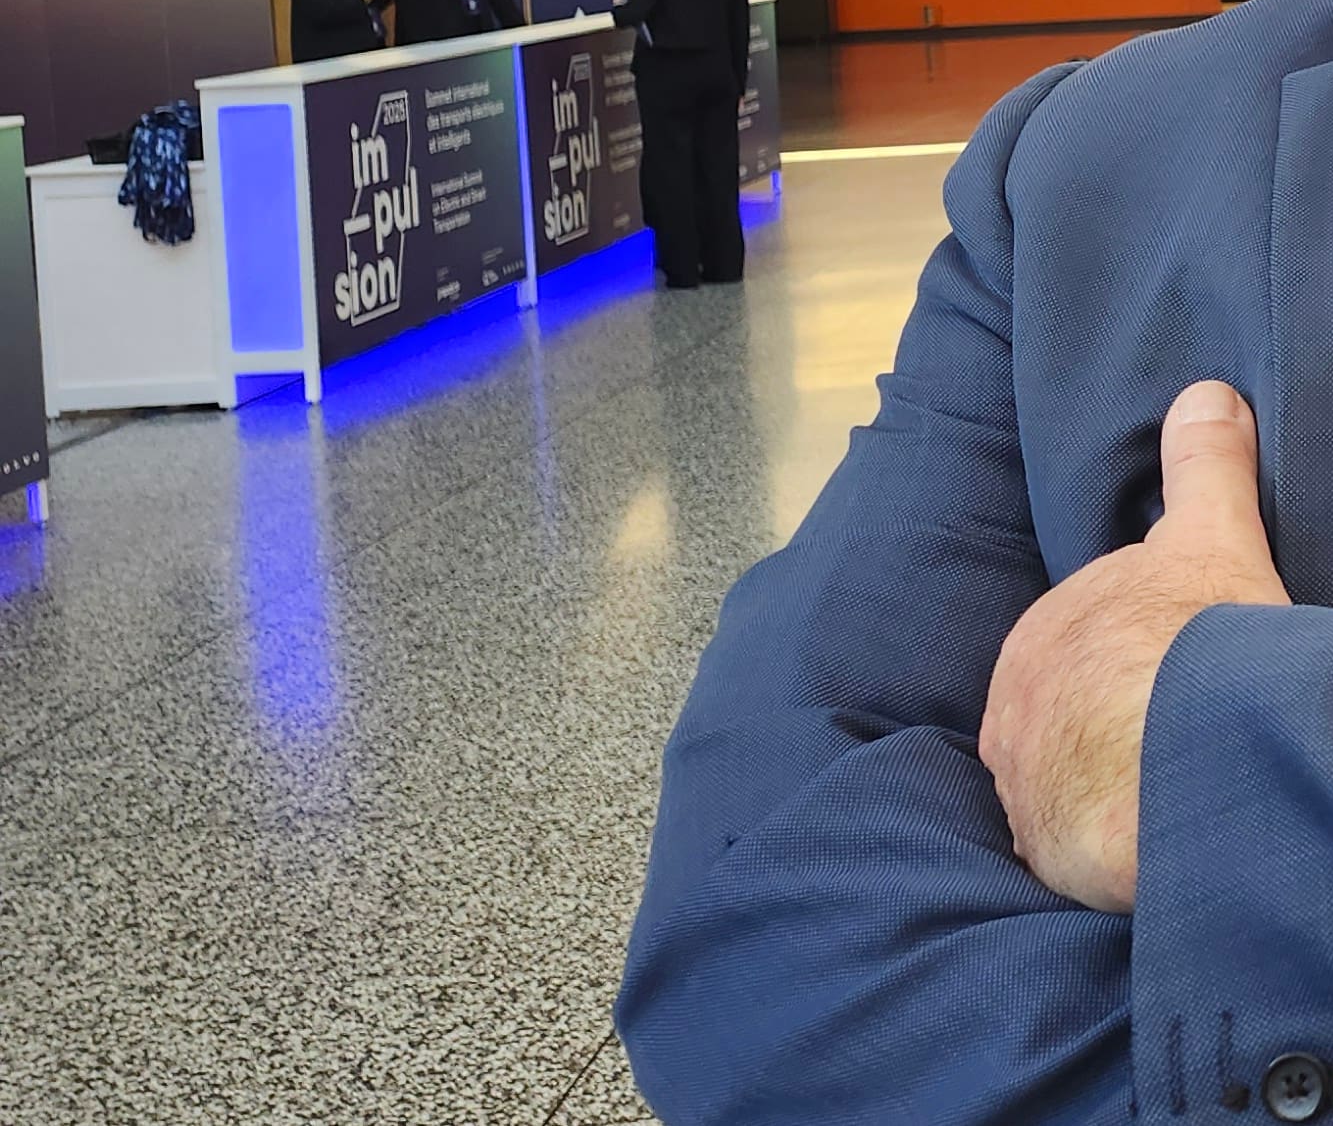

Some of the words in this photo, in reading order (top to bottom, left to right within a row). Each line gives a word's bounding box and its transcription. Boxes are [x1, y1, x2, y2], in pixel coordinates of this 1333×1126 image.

[552, 78, 579, 133] im
[351, 123, 389, 189] im
[544, 182, 587, 240] sion
[335, 251, 396, 321] sion
[0, 451, 40, 474] OLVO
